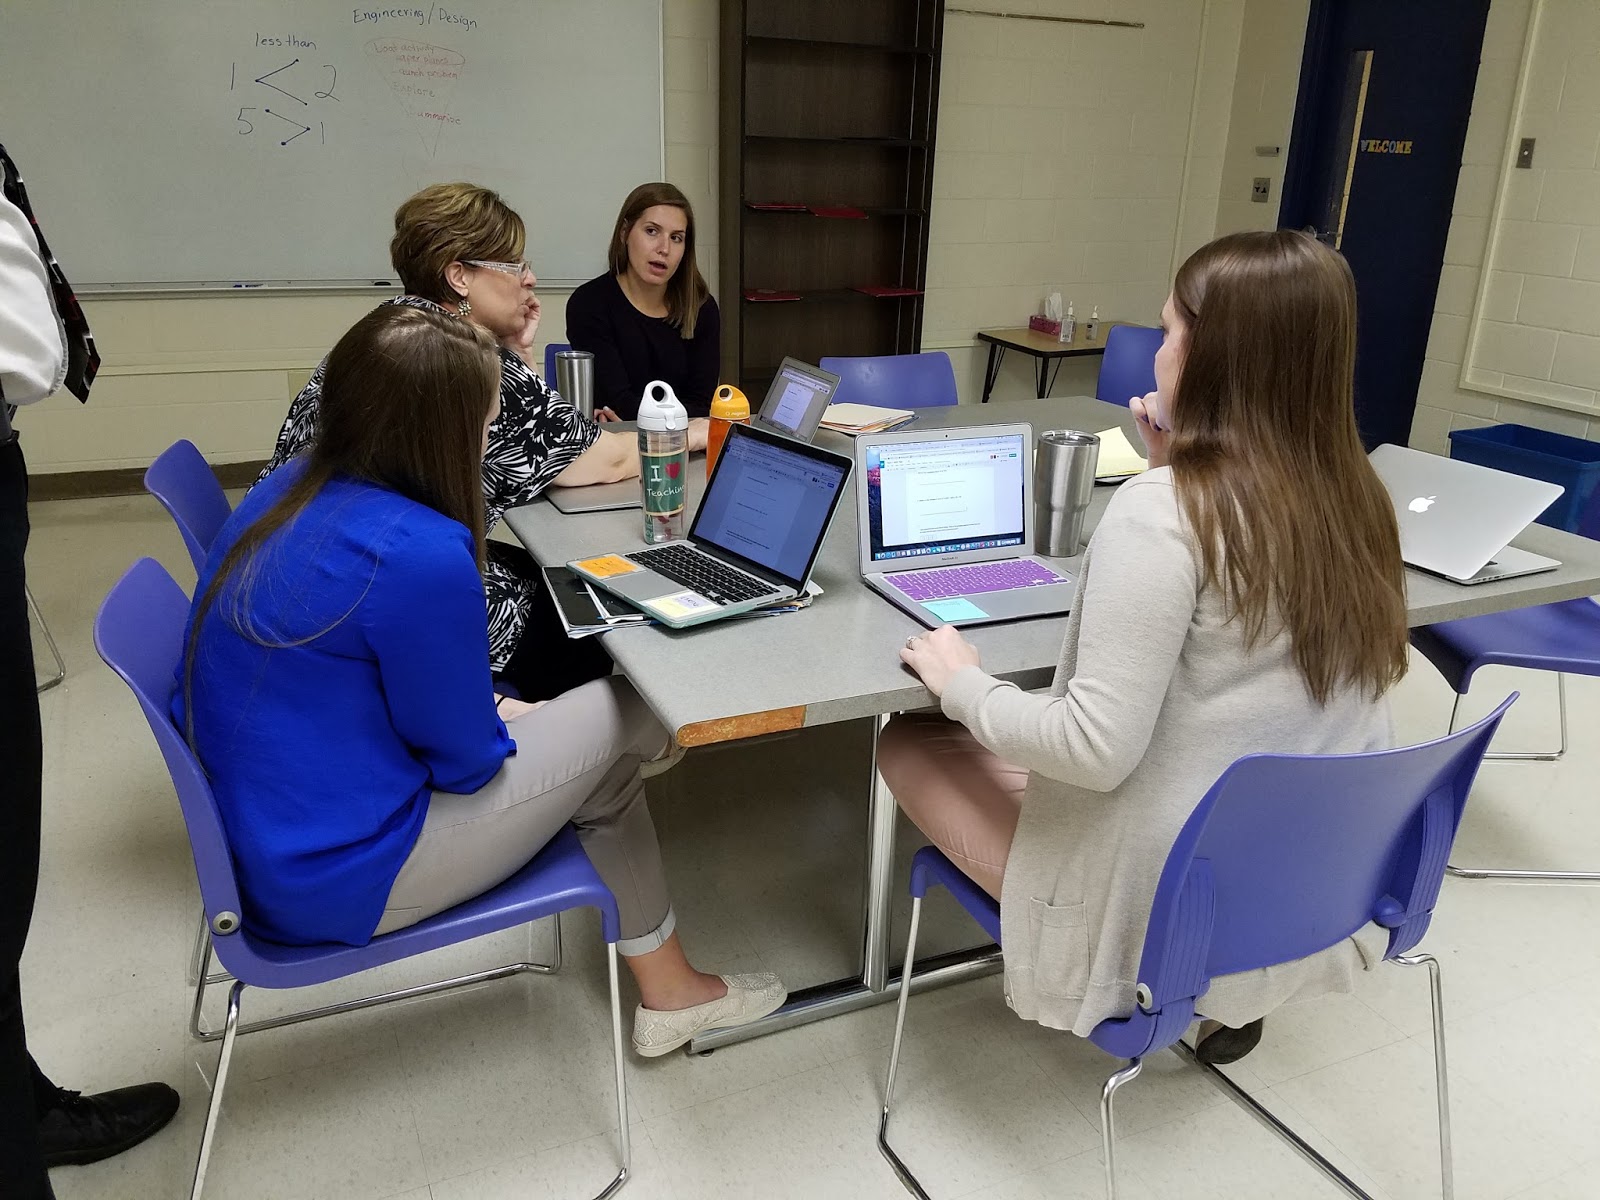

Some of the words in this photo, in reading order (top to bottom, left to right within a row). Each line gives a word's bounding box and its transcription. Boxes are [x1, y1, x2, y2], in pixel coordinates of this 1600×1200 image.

[439, 8, 477, 31] Design
[255, 32, 282, 47] less
[285, 34, 316, 50] than
[314, 65, 340, 101] 2
[237, 107, 256, 135] 5
[411, 111, 461, 125] ummarize
[1360, 139, 1413, 154] WELCOME
[651, 465, 662, 482] I
